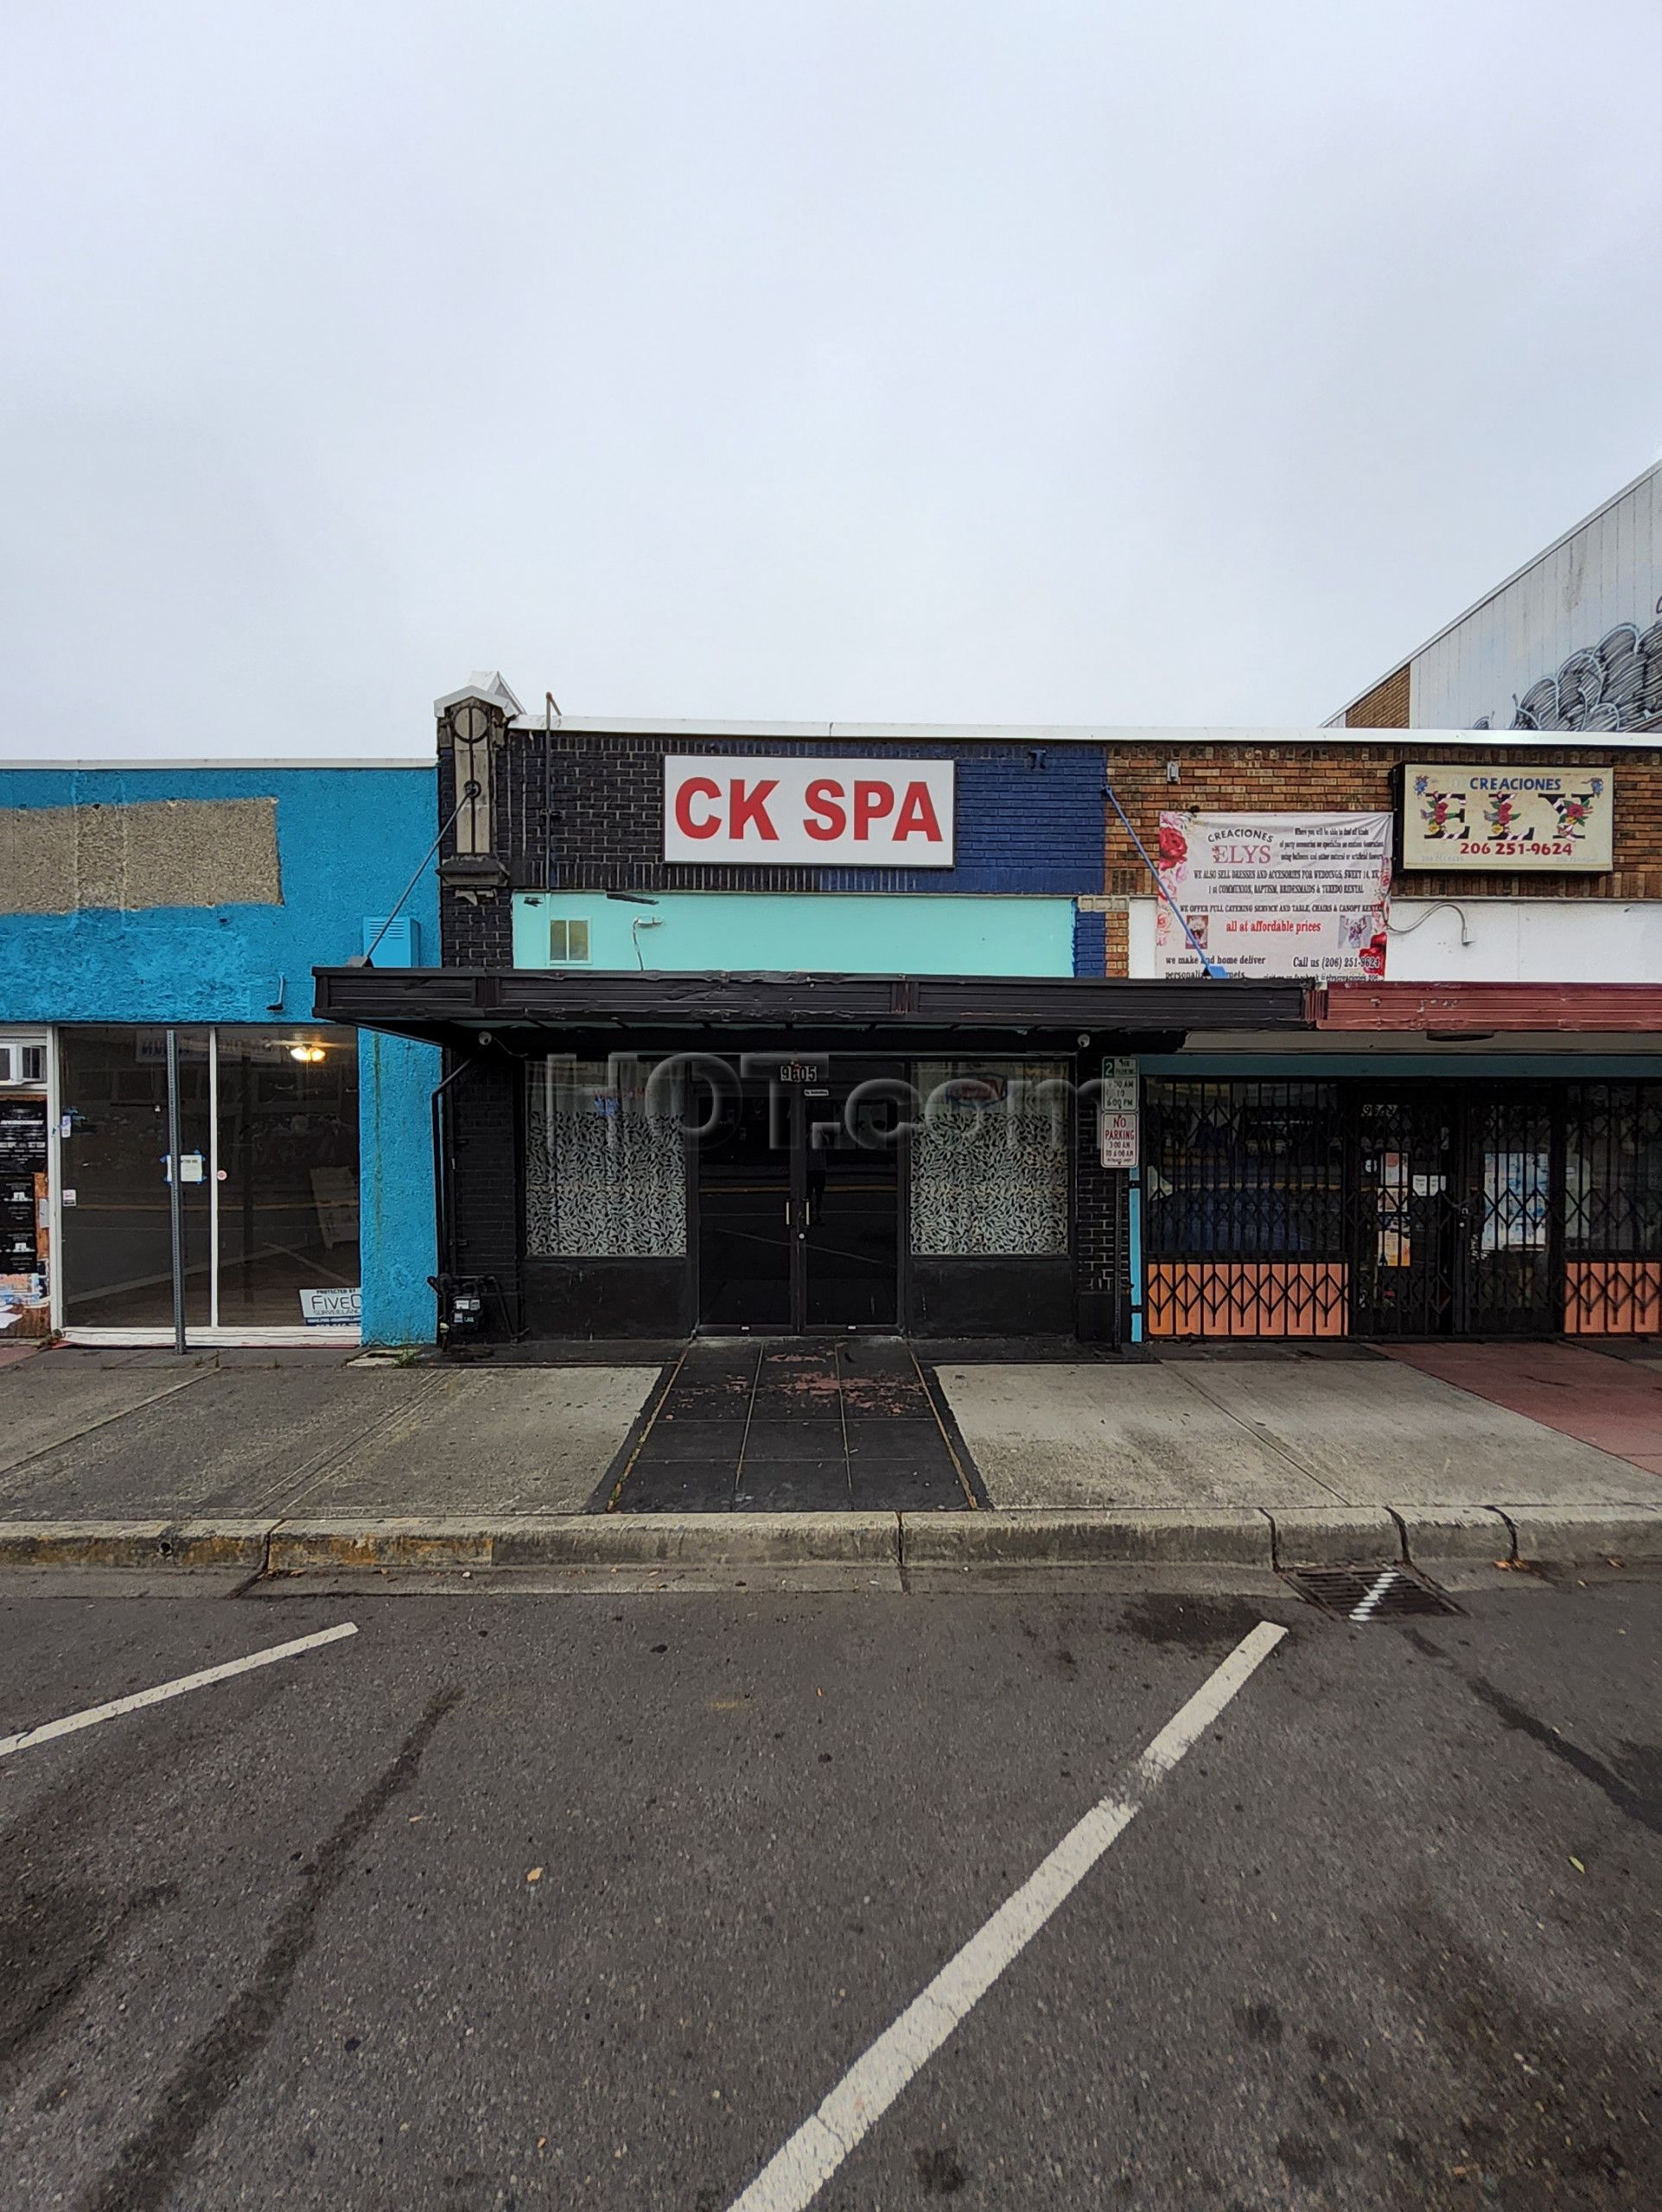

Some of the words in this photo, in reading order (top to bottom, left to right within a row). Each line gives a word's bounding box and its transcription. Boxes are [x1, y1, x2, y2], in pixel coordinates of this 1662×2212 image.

[1469, 778, 1562, 790] CREACIONES
[675, 777, 780, 840] CK
[803, 779, 944, 842] SPA
[1207, 829, 1274, 842] CREACIONES
[1212, 845, 1271, 863] ELYS
[1460, 842, 1491, 855] 206
[1495, 842, 1572, 855] 251-9624
[1203, 870, 1216, 879] ALSO
[1218, 870, 1231, 879] SELL
[1257, 870, 1267, 879] AND
[1226, 921, 1237, 931] all
[1239, 921, 1248, 931] at
[1251, 920, 1294, 931] affordable
[1296, 920, 1321, 935] prices
[1178, 956, 1198, 964] make
[1217, 956, 1238, 964] home
[1239, 956, 1266, 964] deliver
[1293, 957, 1309, 968] Call
[1310, 959, 1320, 968] us
[1321, 956, 1342, 969] (206)
[1344, 957, 1379, 968] 251-9624
[1105, 1062, 1113, 1076] 2
[1113, 1116, 1126, 1128] NO
[1105, 1129, 1134, 1140] PARKING
